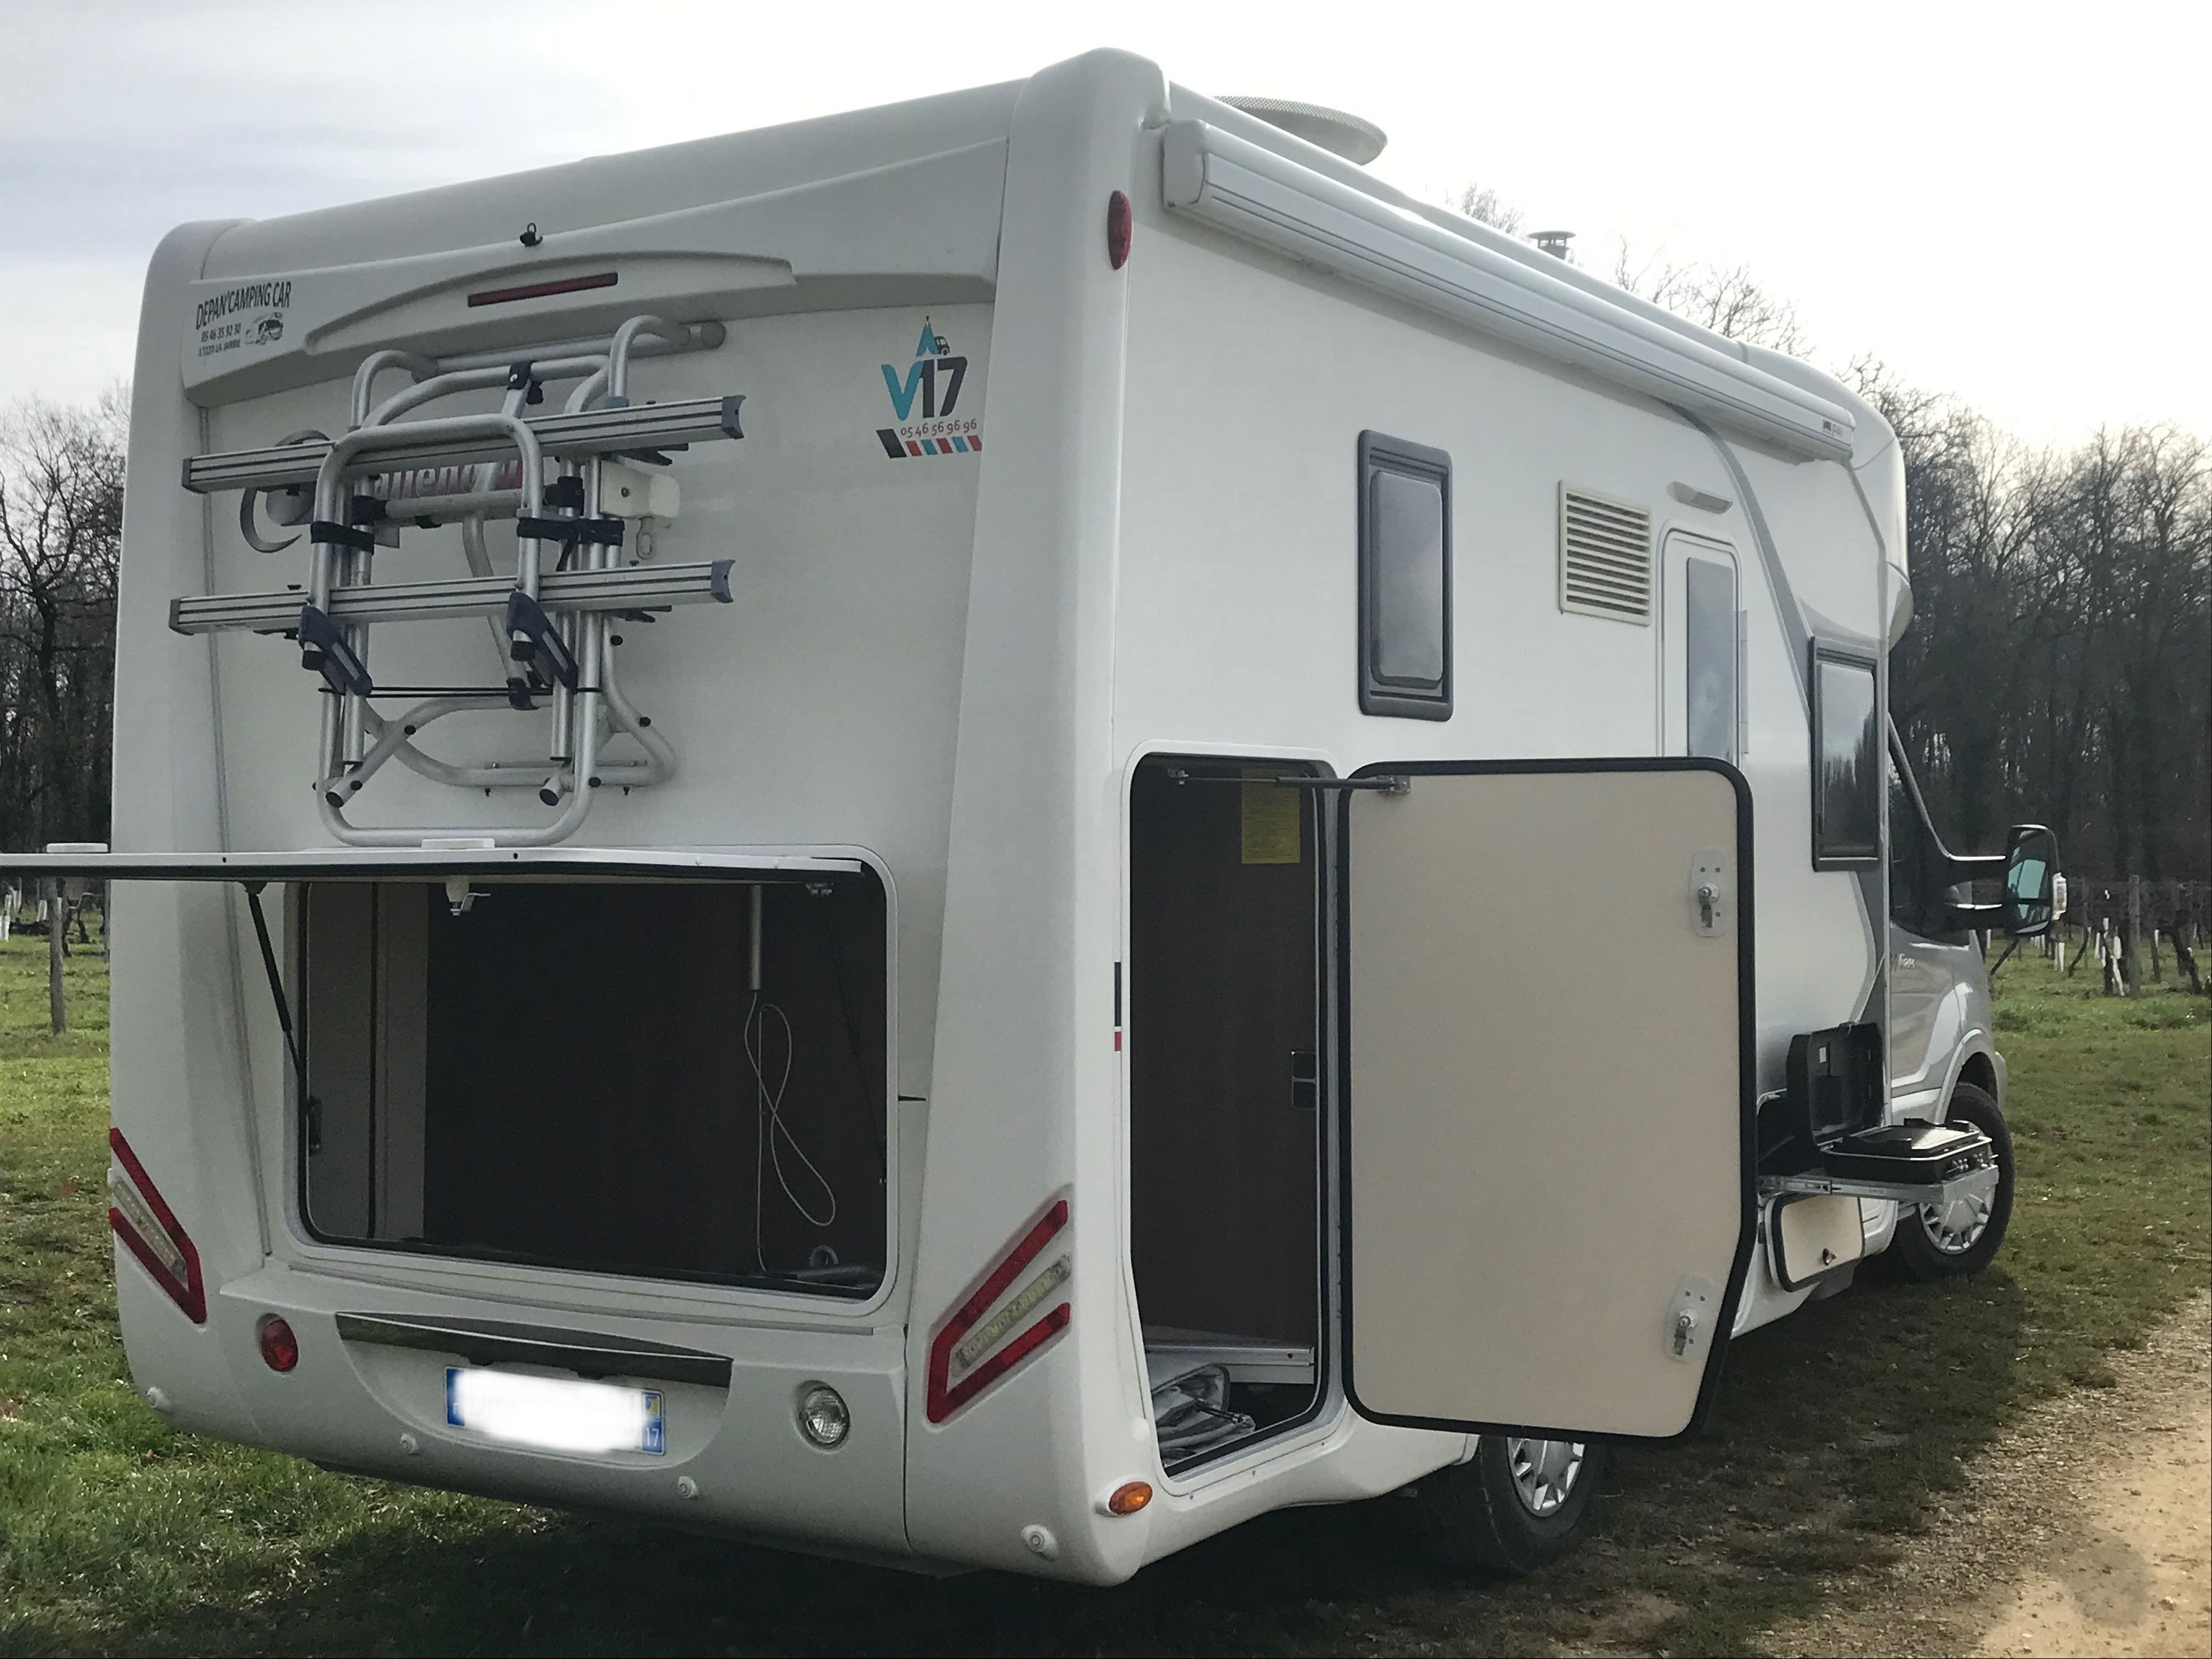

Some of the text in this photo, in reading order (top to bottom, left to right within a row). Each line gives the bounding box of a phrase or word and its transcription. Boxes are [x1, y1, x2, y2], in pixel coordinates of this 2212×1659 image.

[272, 281, 292, 308] CAR
[900, 418, 977, 438] 05 46 56 96 96
[645, 1426, 659, 1447] 17
